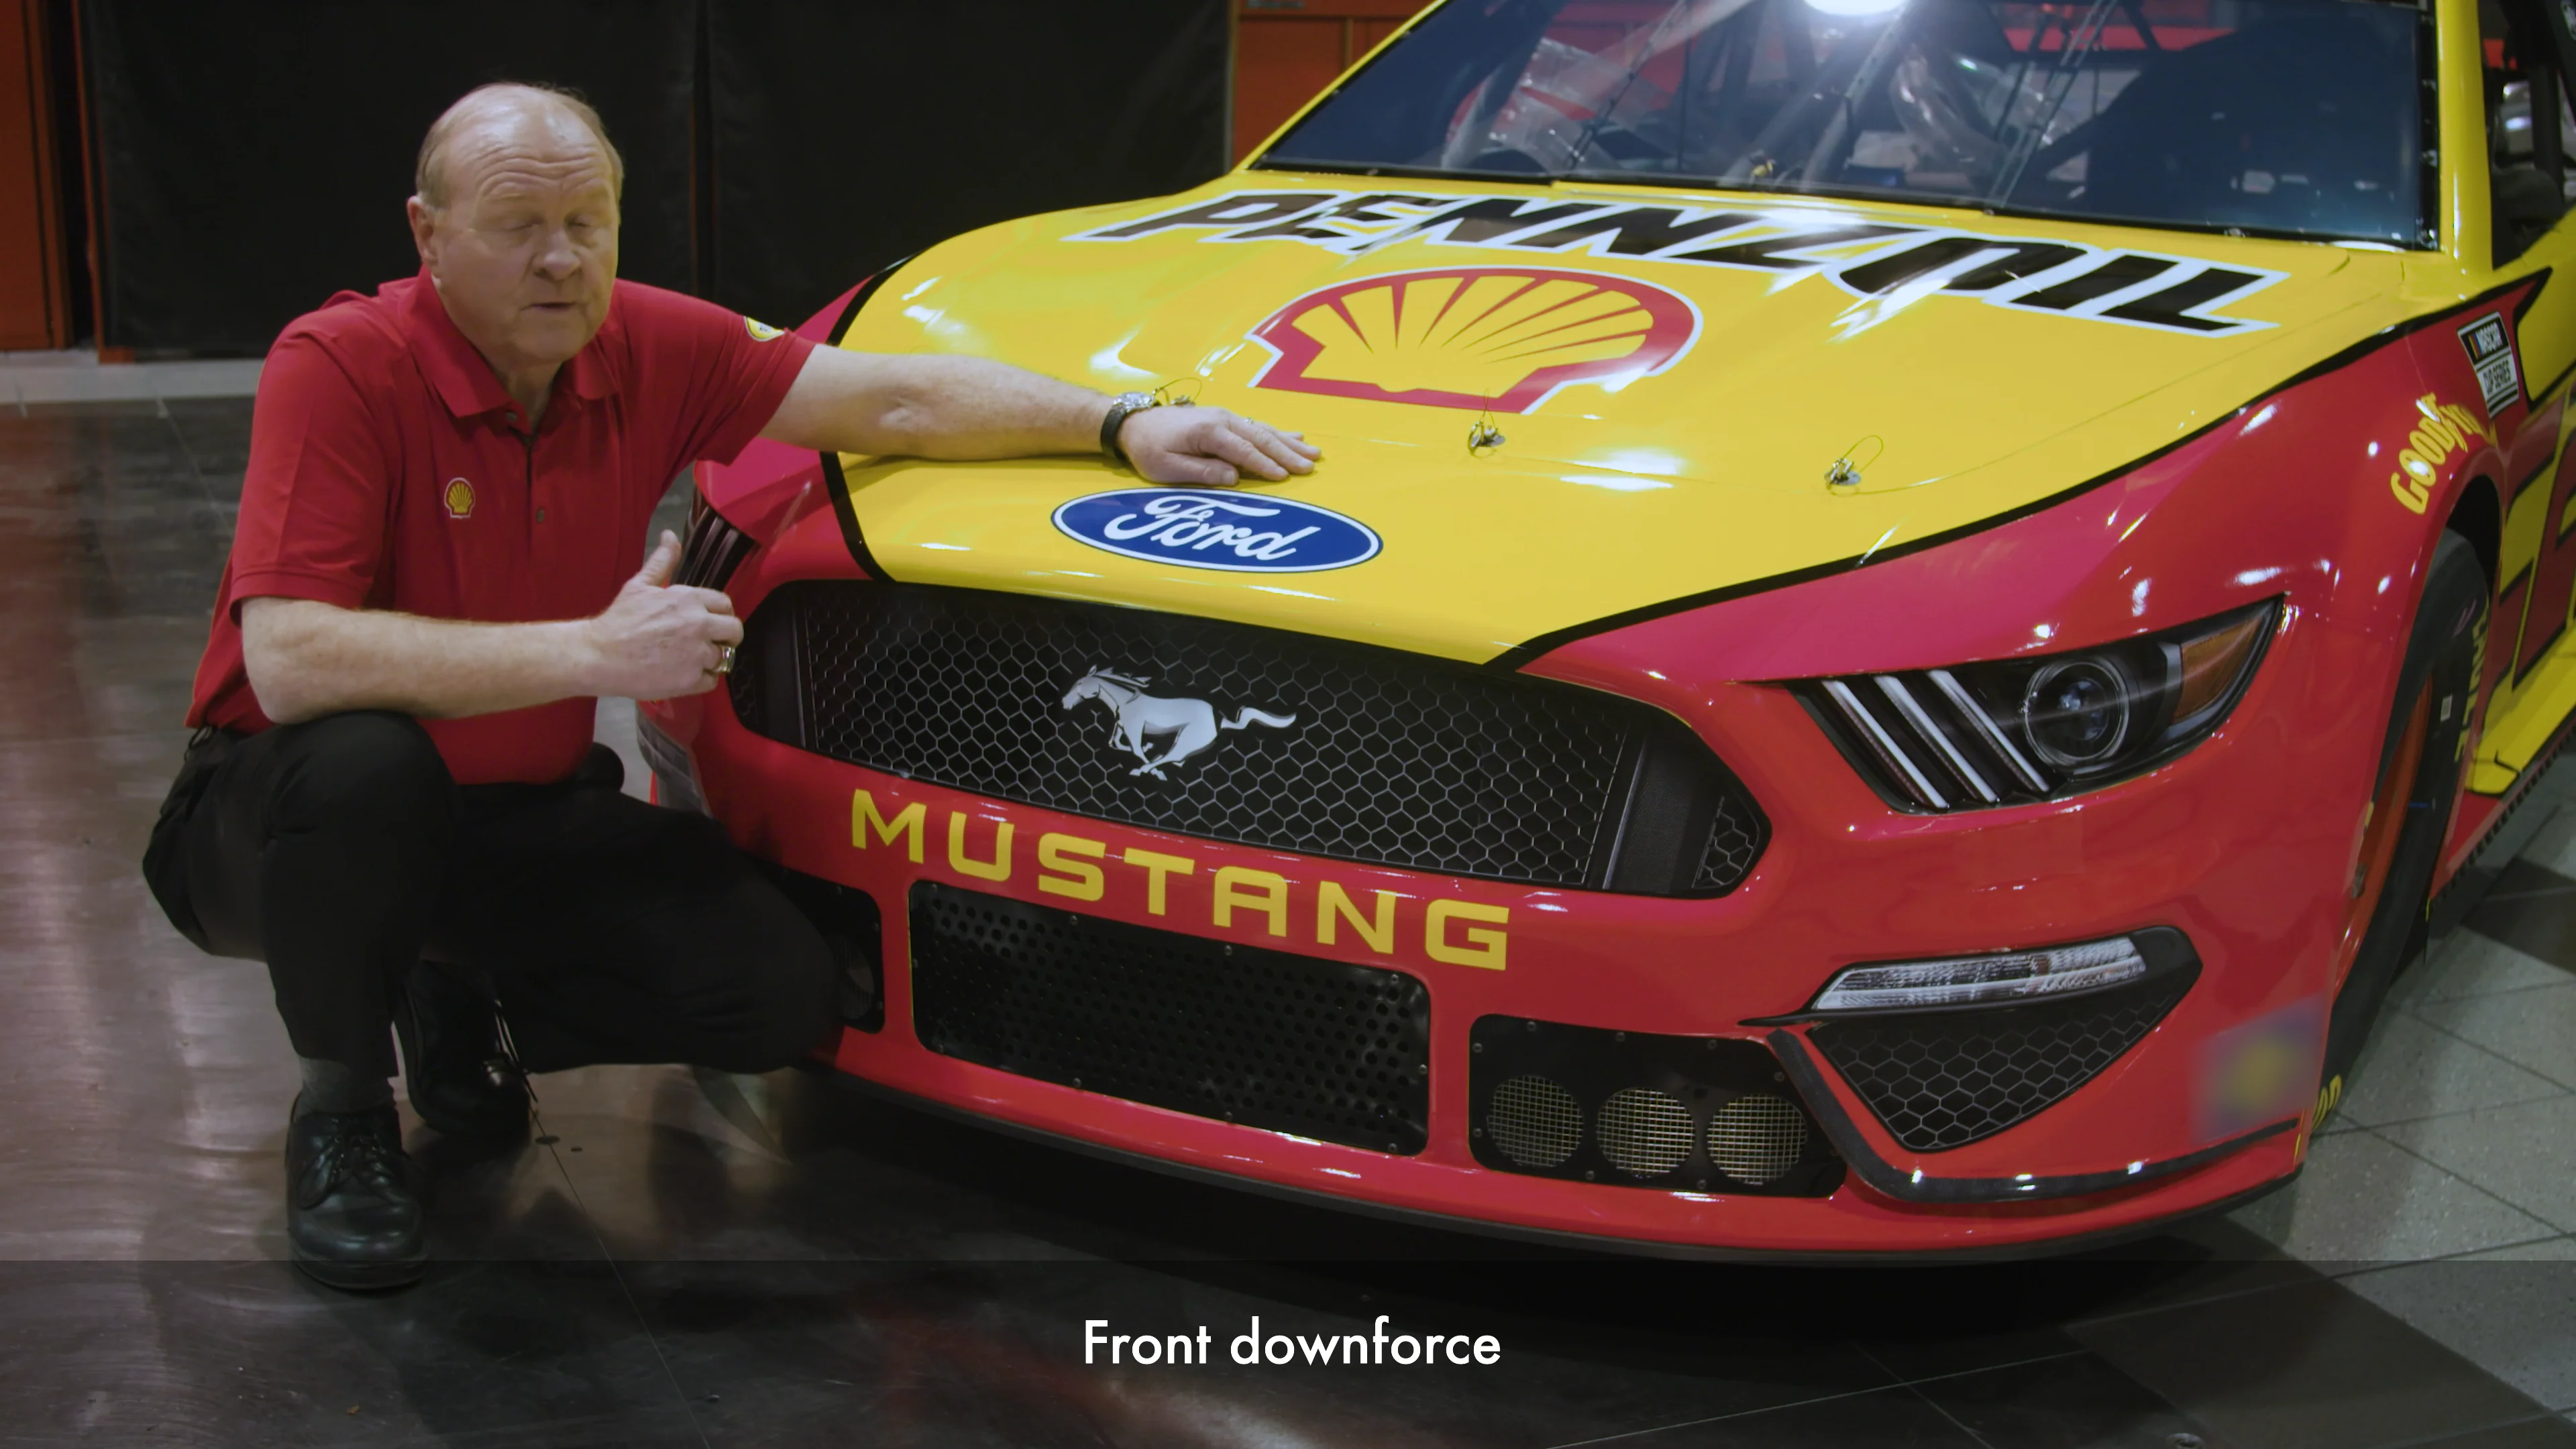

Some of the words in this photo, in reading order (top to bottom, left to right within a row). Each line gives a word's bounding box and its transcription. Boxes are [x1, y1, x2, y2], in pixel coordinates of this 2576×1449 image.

[1067, 191, 2286, 336] PENNZOIL
[1104, 495, 1322, 561] Ford
[851, 788, 1510, 971] MUSTANG
